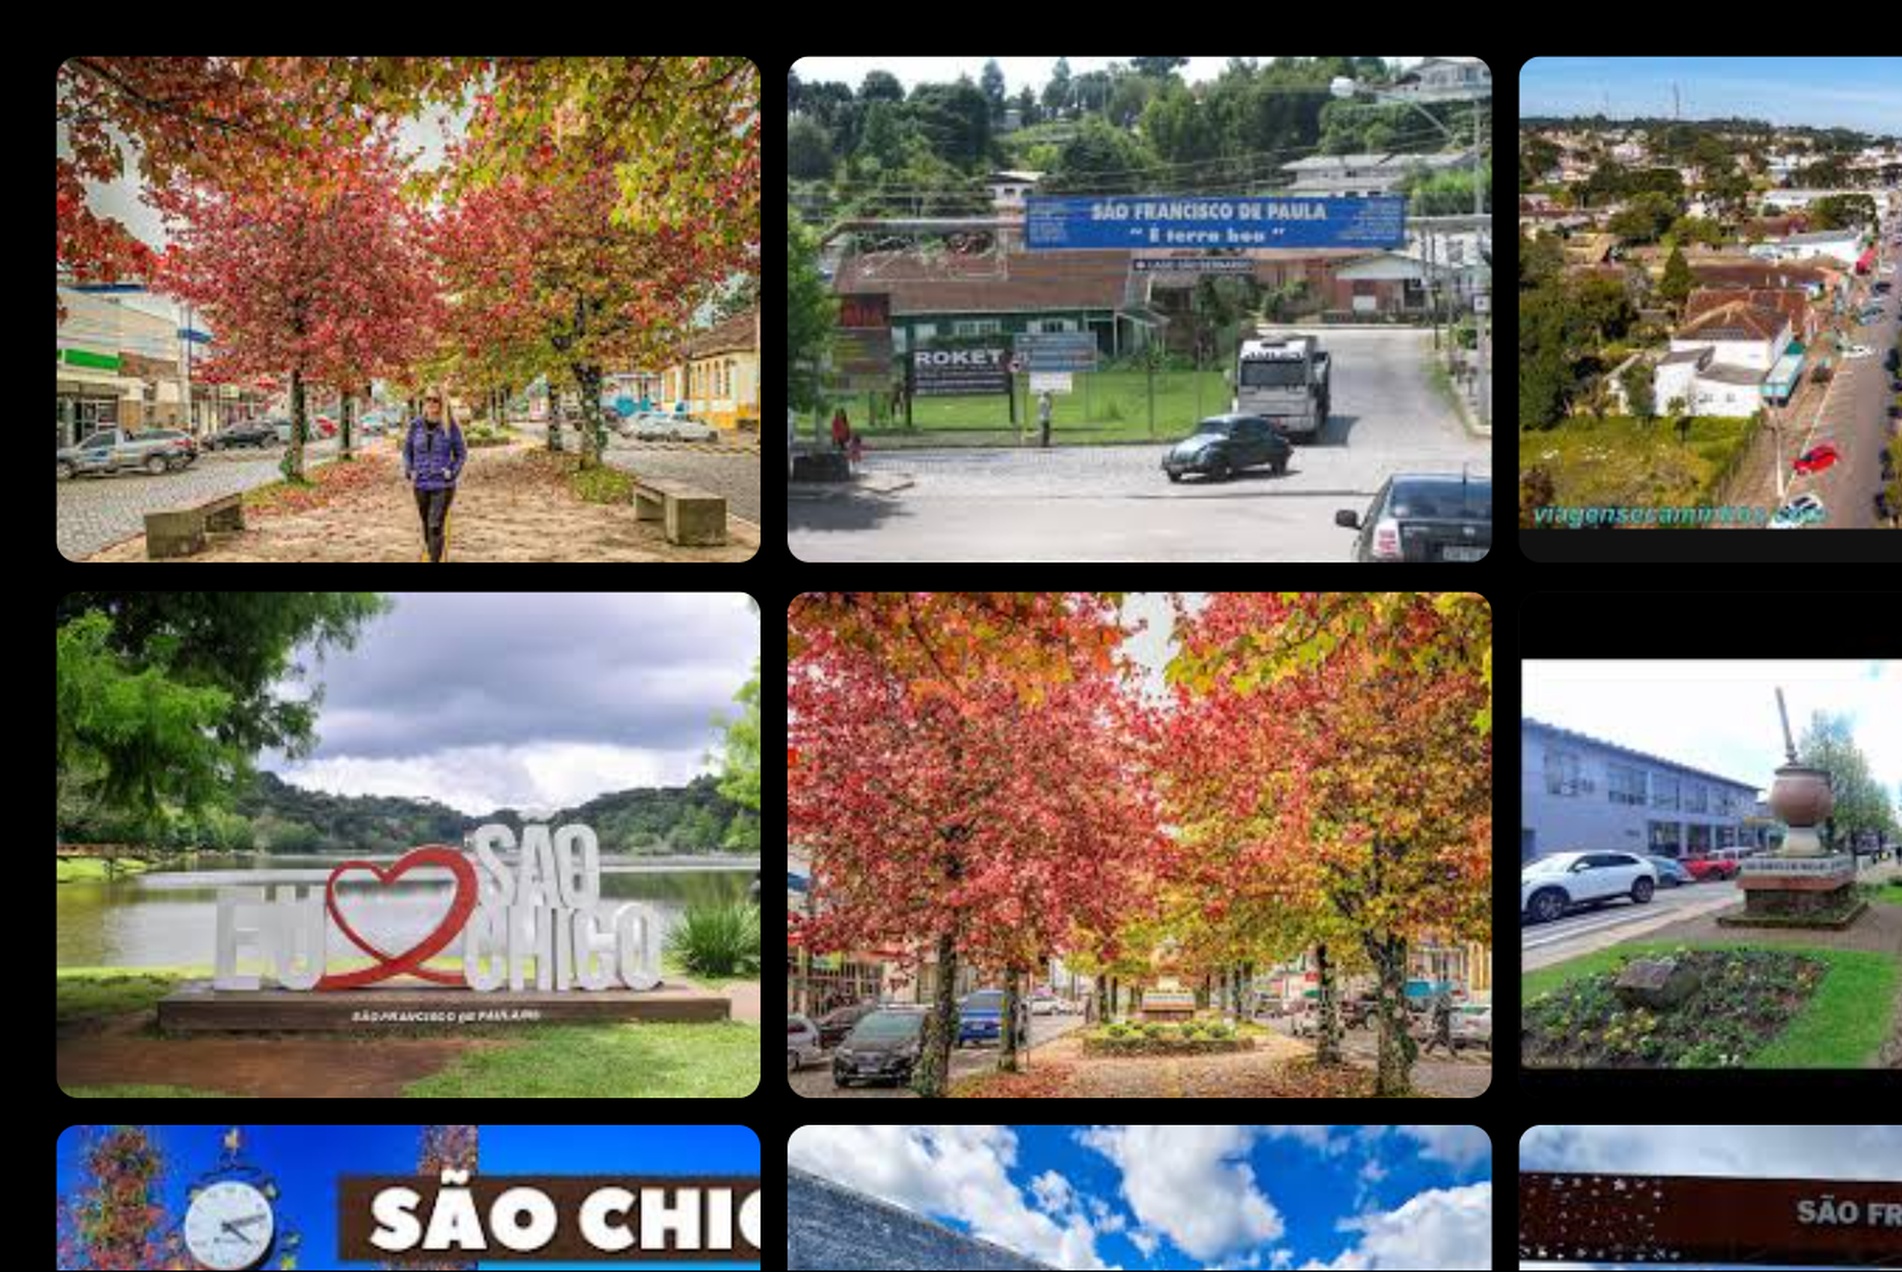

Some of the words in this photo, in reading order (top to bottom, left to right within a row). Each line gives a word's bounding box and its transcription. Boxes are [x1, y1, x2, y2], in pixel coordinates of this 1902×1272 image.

[1135, 202, 1233, 220] FRANCISCO
[1238, 202, 1261, 220] DE
[1268, 202, 1327, 220] PAULA
[1166, 228, 1219, 243] terra
[913, 348, 1005, 367] ROKET
[474, 807, 601, 910] SÃO
[213, 885, 326, 991] EU
[463, 903, 663, 991] CHICO
[381, 1011, 457, 1022] FRANCISCO
[369, 1169, 558, 1252] SÃO
[1797, 1194, 1860, 1225] SÃO
